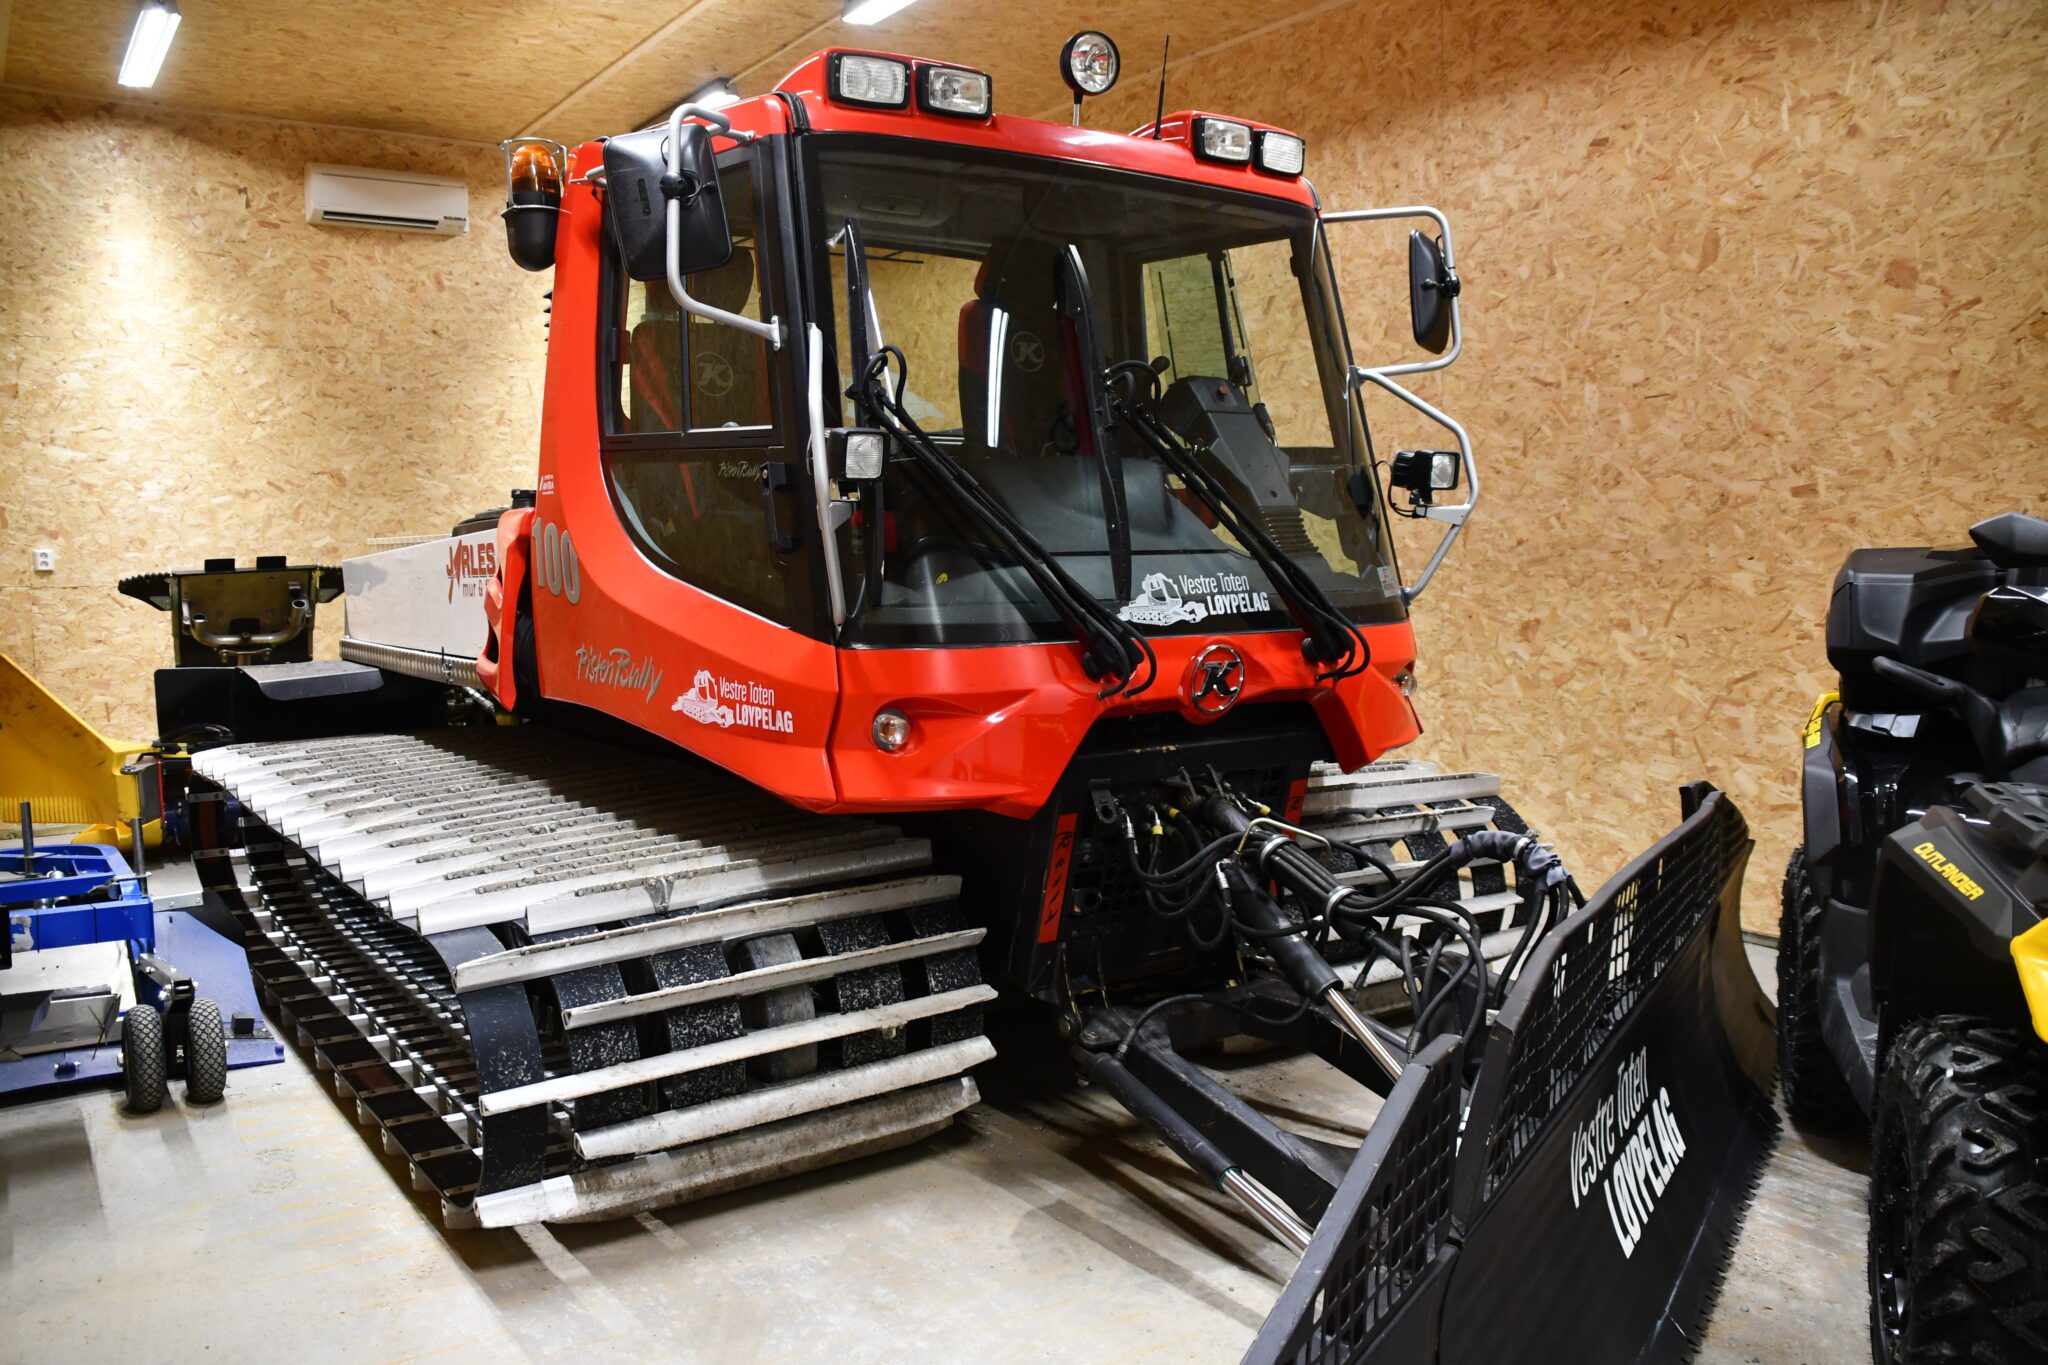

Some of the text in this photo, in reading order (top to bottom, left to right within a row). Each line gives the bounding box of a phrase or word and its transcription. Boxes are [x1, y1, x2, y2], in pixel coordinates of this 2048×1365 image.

[532, 517, 581, 605] 100
[1178, 572, 1250, 595] Vestre Toten
[1206, 591, 1271, 616] LØYPELAG
[575, 643, 663, 704] PistenBully
[719, 676, 775, 707] Vestre Toten
[735, 702, 794, 734] LØYPELAG
[1913, 842, 1985, 901] OUTLANDER
[1570, 1045, 1649, 1209] Vestre Toten
[1603, 1086, 1687, 1259] LØYPELAG
